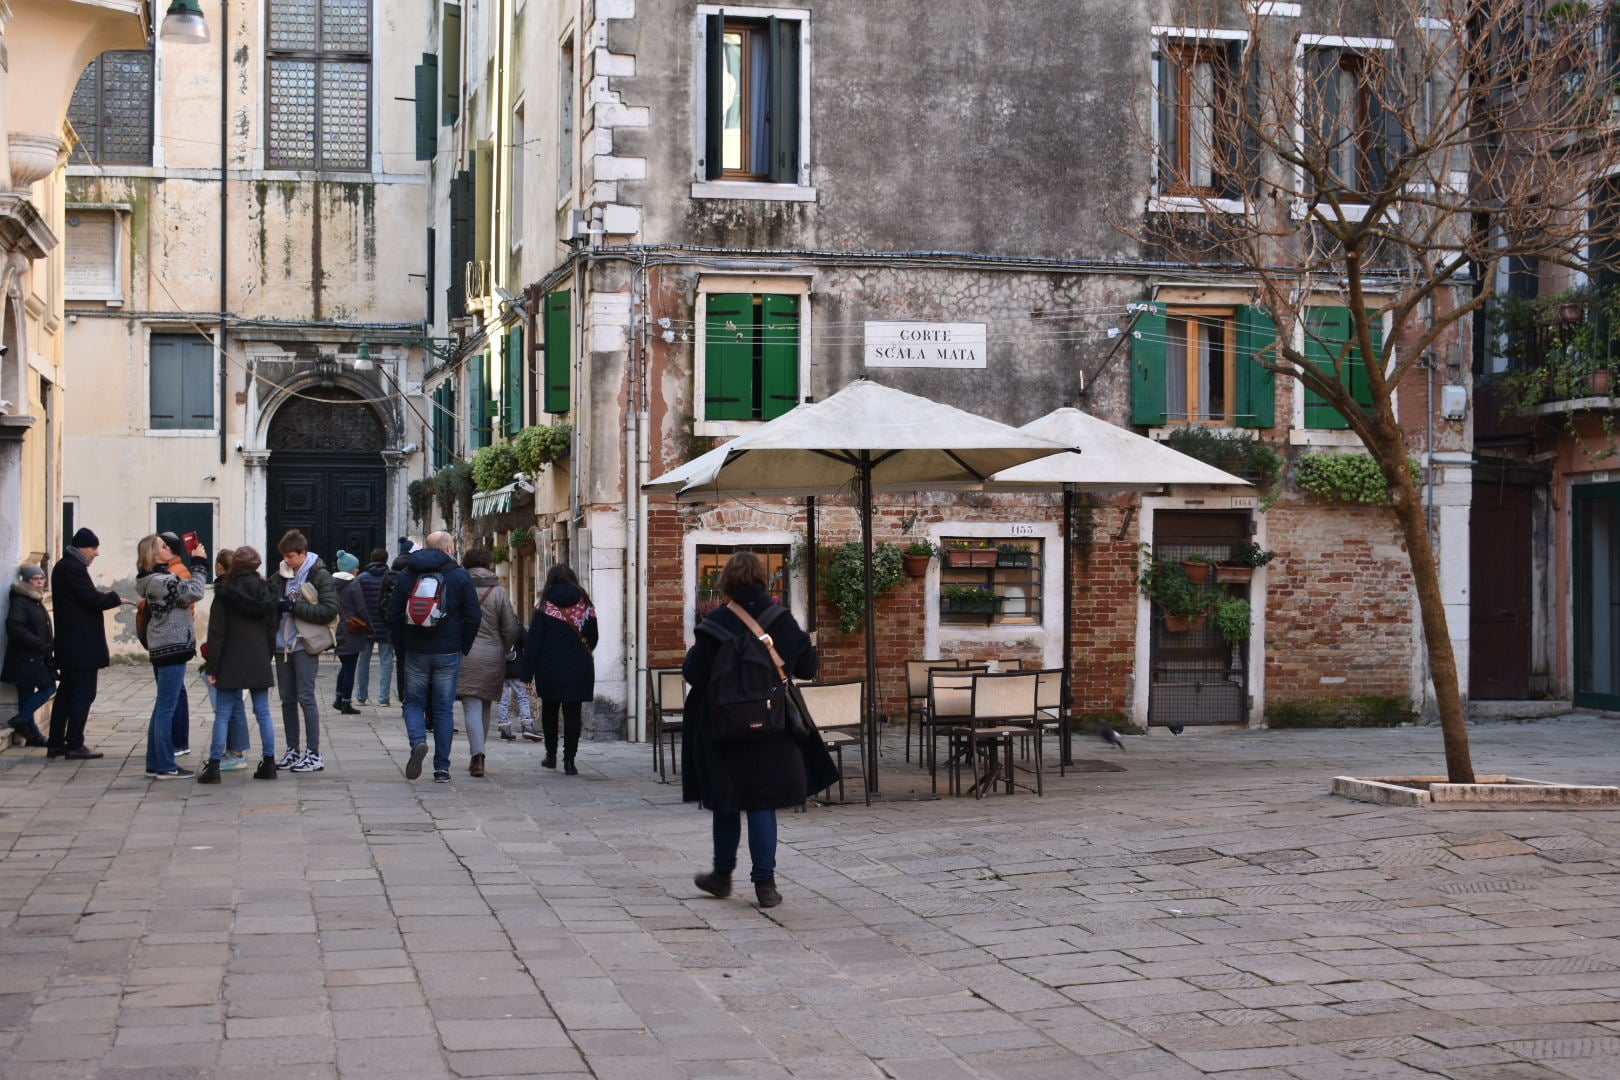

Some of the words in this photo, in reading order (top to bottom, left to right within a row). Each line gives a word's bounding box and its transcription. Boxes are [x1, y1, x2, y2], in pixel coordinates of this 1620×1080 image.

[900, 329, 952, 342] CORTE
[875, 347, 926, 360] SCALA
[937, 348, 976, 361] MATA
